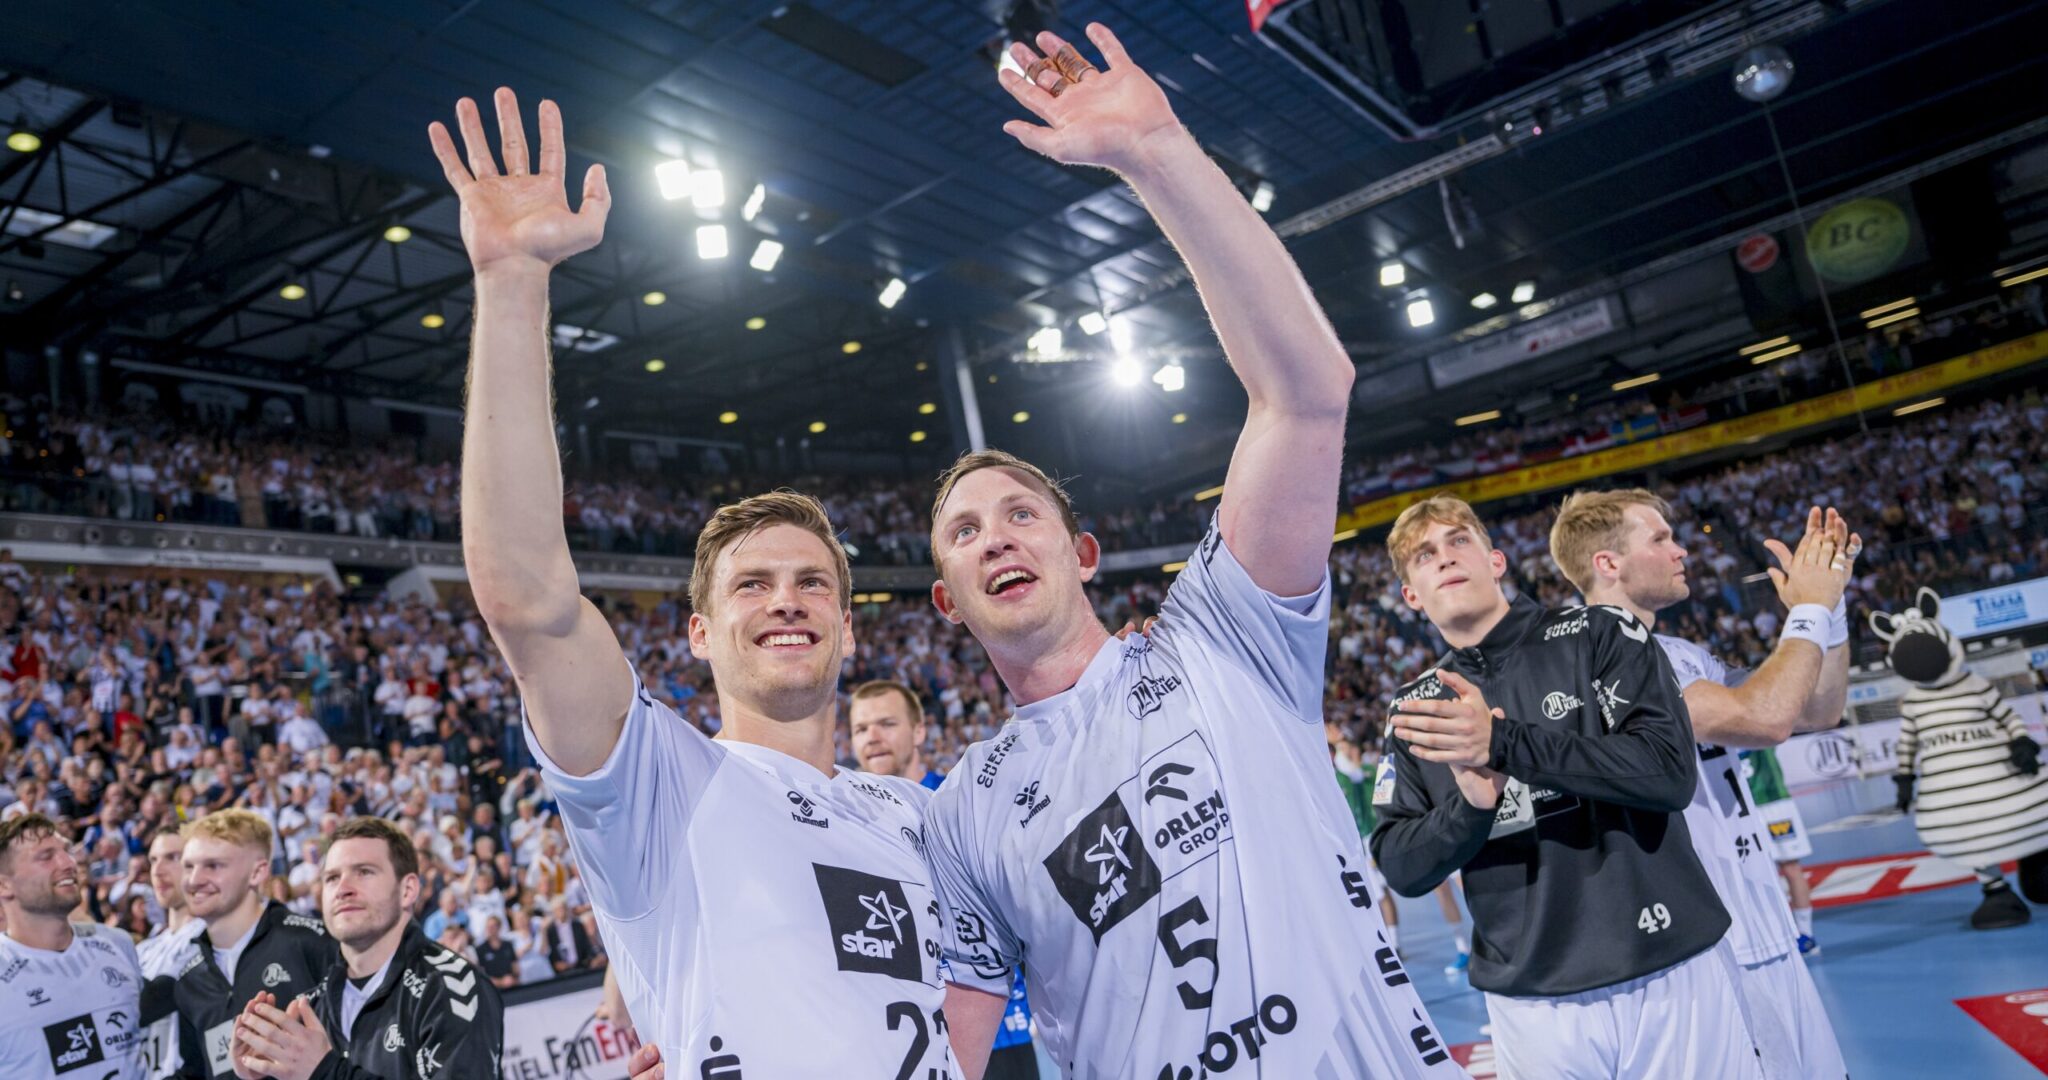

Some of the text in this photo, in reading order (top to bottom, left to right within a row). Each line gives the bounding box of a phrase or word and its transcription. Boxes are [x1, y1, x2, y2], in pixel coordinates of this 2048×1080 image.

[1828, 216, 1882, 249] BC
[1154, 675, 1182, 701] KIEL
[1564, 697, 1585, 711] KIEL
[1918, 726, 1996, 752] OVINZIAL
[791, 811, 829, 829] hummel
[1019, 794, 1051, 829] hummel
[1155, 789, 1225, 850] ORLEN
[1637, 902, 1672, 935] 49
[841, 929, 896, 960] star
[1158, 895, 1220, 1010] 5
[56, 1048, 90, 1068] star
